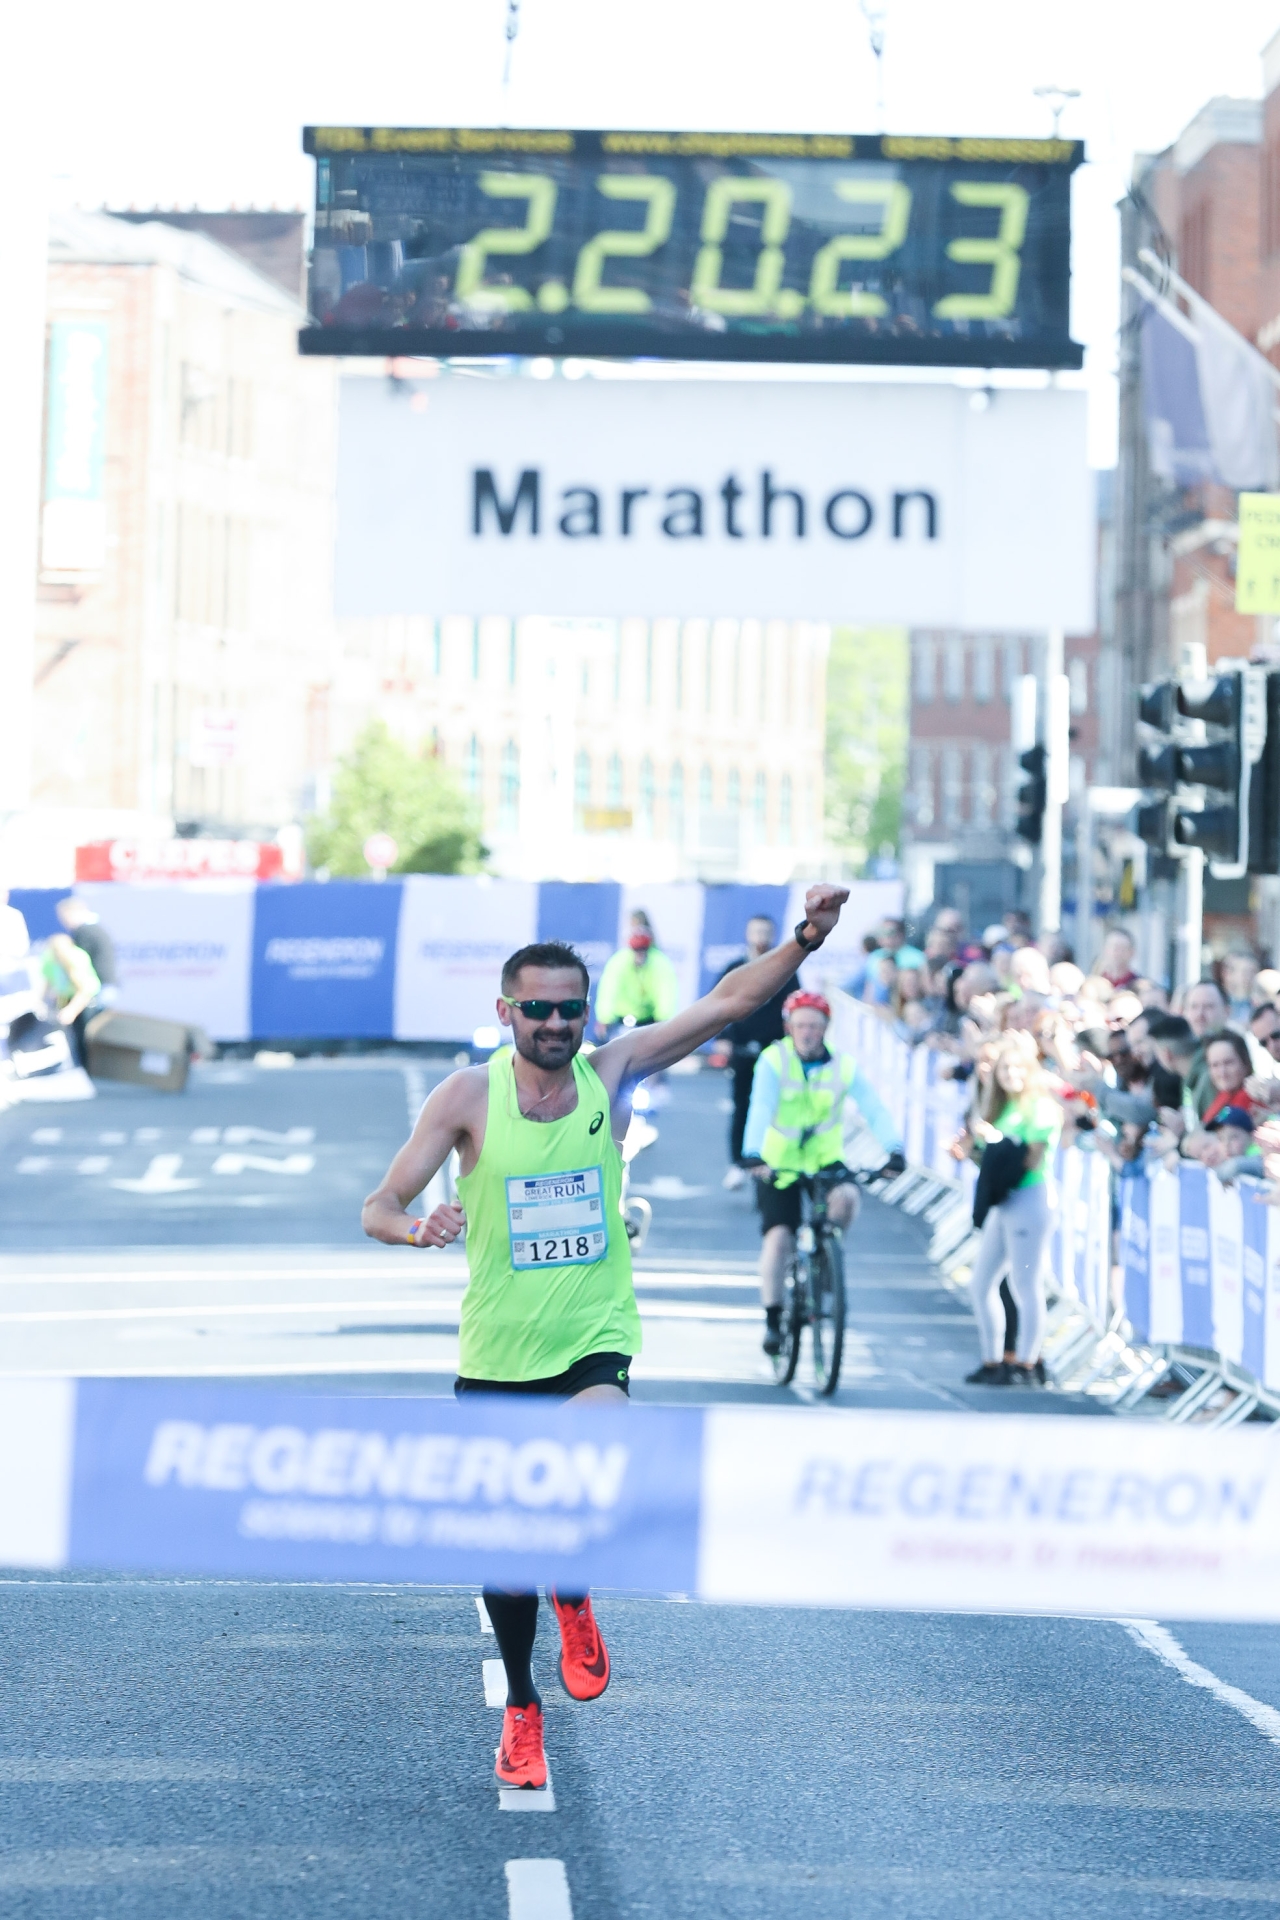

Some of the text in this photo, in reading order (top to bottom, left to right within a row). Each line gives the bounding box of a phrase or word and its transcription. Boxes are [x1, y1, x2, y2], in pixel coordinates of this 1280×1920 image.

[471, 467, 939, 539] Marathon
[524, 1182, 586, 1198] GREAT RUN
[530, 1236, 589, 1262] 1218
[538, 1229, 579, 1239] MARATHON
[145, 1419, 629, 1510] REGENERON
[792, 1456, 1266, 1528] REGENERON
